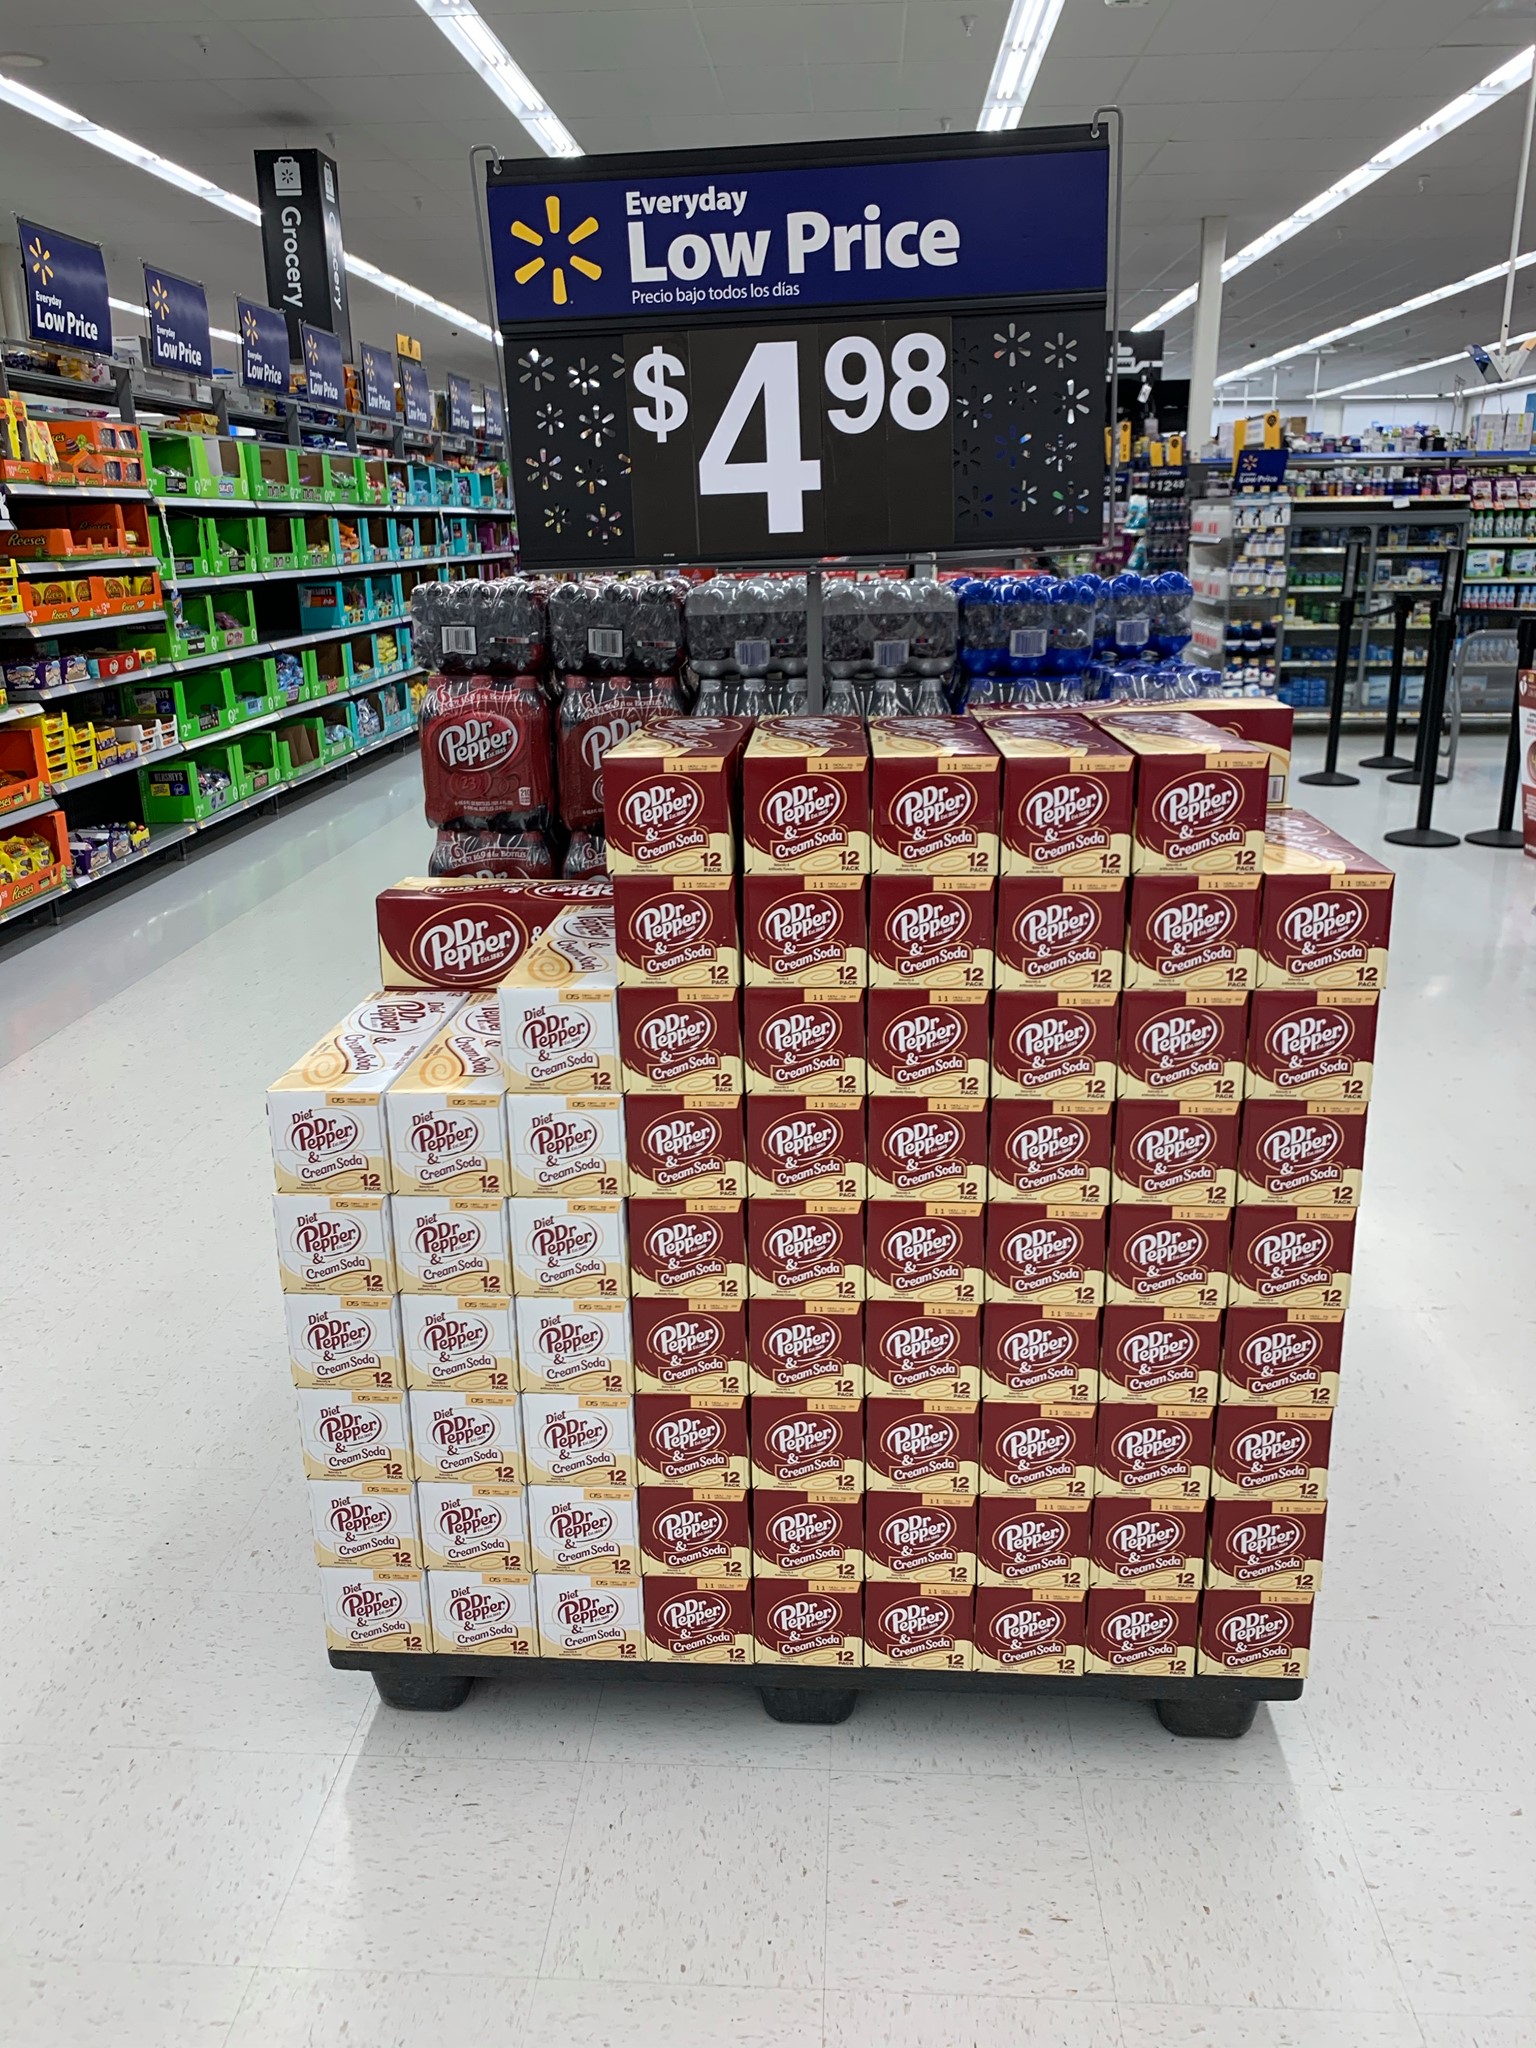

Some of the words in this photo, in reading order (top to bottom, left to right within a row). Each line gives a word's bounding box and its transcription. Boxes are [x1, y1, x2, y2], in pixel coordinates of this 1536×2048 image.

[625, 185, 748, 219] Everyday
[627, 221, 772, 283] Low
[786, 204, 961, 275] Price
[281, 206, 304, 308] Grocery
[328, 211, 342, 311] Gocery
[35, 291, 62, 310] Everyday
[631, 290, 673, 305] Precio
[675, 288, 706, 305] bajo
[708, 284, 748, 300] todos
[750, 283, 770, 298] los
[772, 281, 800, 297] días
[36, 304, 65, 331] Low
[67, 311, 99, 341] Price
[157, 335, 178, 361] Low
[179, 341, 202, 367] Price
[247, 360, 264, 381] Low
[264, 364, 282, 385] Price
[310, 378, 323, 396] Low
[323, 381, 338, 400] Price
[368, 391, 379, 407] Low
[378, 395, 391, 411] Price
[7, 533, 46, 547] Reese's
[464, 719, 493, 744] Dr
[438, 725, 512, 767] Pepper
[650, 786, 676, 807] Dr
[1053, 786, 1080, 807] Dr
[625, 791, 693, 827] Pepper
[1026, 791, 1097, 827] Pepper
[644, 827, 659, 840] &
[1044, 827, 1059, 841] &
[637, 841, 676, 859] Cream
[675, 830, 703, 847] Soda
[1034, 842, 1075, 860] Cream
[1075, 831, 1104, 848] Soda
[701, 852, 722, 866] 12
[1100, 854, 1121, 868] 12
[1312, 902, 1339, 922] Dr
[452, 917, 489, 950] Dr
[1285, 907, 1356, 942] Pepper
[420, 923, 512, 971] Pepper
[1301, 941, 1316, 954] &
[1291, 955, 1332, 972] Cream
[1333, 945, 1362, 961] Soda
[1357, 967, 1378, 980] 12
[524, 1006, 546, 1022] Diet
[546, 1015, 569, 1034] Dr
[523, 1020, 585, 1049] Pepper
[539, 1049, 552, 1062] &
[531, 1062, 566, 1078] Cream
[568, 1053, 593, 1067] Soda
[590, 1072, 611, 1085] 12
[292, 1109, 313, 1124] Diet
[292, 1122, 353, 1151] Pepper
[314, 1118, 336, 1136] Dr
[308, 1151, 321, 1163] &
[302, 1164, 336, 1179] Cream
[337, 1155, 362, 1169] Soda
[360, 1174, 380, 1186] 12
[911, 1227, 936, 1244] Dr
[888, 1231, 952, 1261] Pepper
[904, 1261, 917, 1272] &
[896, 1273, 932, 1288] Cream
[932, 1265, 958, 1279] Soda
[955, 1284, 974, 1296] 12
[425, 1312, 445, 1326] Diet
[424, 1325, 483, 1351] Pepper
[446, 1321, 468, 1337] Dr
[433, 1363, 466, 1377] Cream
[467, 1355, 491, 1368] Soda
[439, 1351, 452, 1362] &
[488, 1373, 508, 1384] 12
[1142, 1428, 1166, 1444] Dr
[1118, 1432, 1181, 1460] Pepper
[1124, 1470, 1160, 1484] Cream
[1160, 1463, 1186, 1476] Soda
[1132, 1459, 1146, 1470] &
[1182, 1481, 1200, 1492] 12
[559, 1590, 578, 1602] Diet
[579, 1598, 599, 1612] Dr
[558, 1601, 614, 1624] Pepper
[773, 1605, 832, 1631] Pepper
[795, 1602, 818, 1617] Dr
[565, 1634, 596, 1647] Cream
[598, 1628, 621, 1639] Soda
[572, 1624, 584, 1634] &
[788, 1630, 801, 1640] &
[618, 1644, 636, 1654] 12
[781, 1640, 815, 1653] Cream
[815, 1634, 839, 1646] Soda
[837, 1650, 854, 1660] 12
